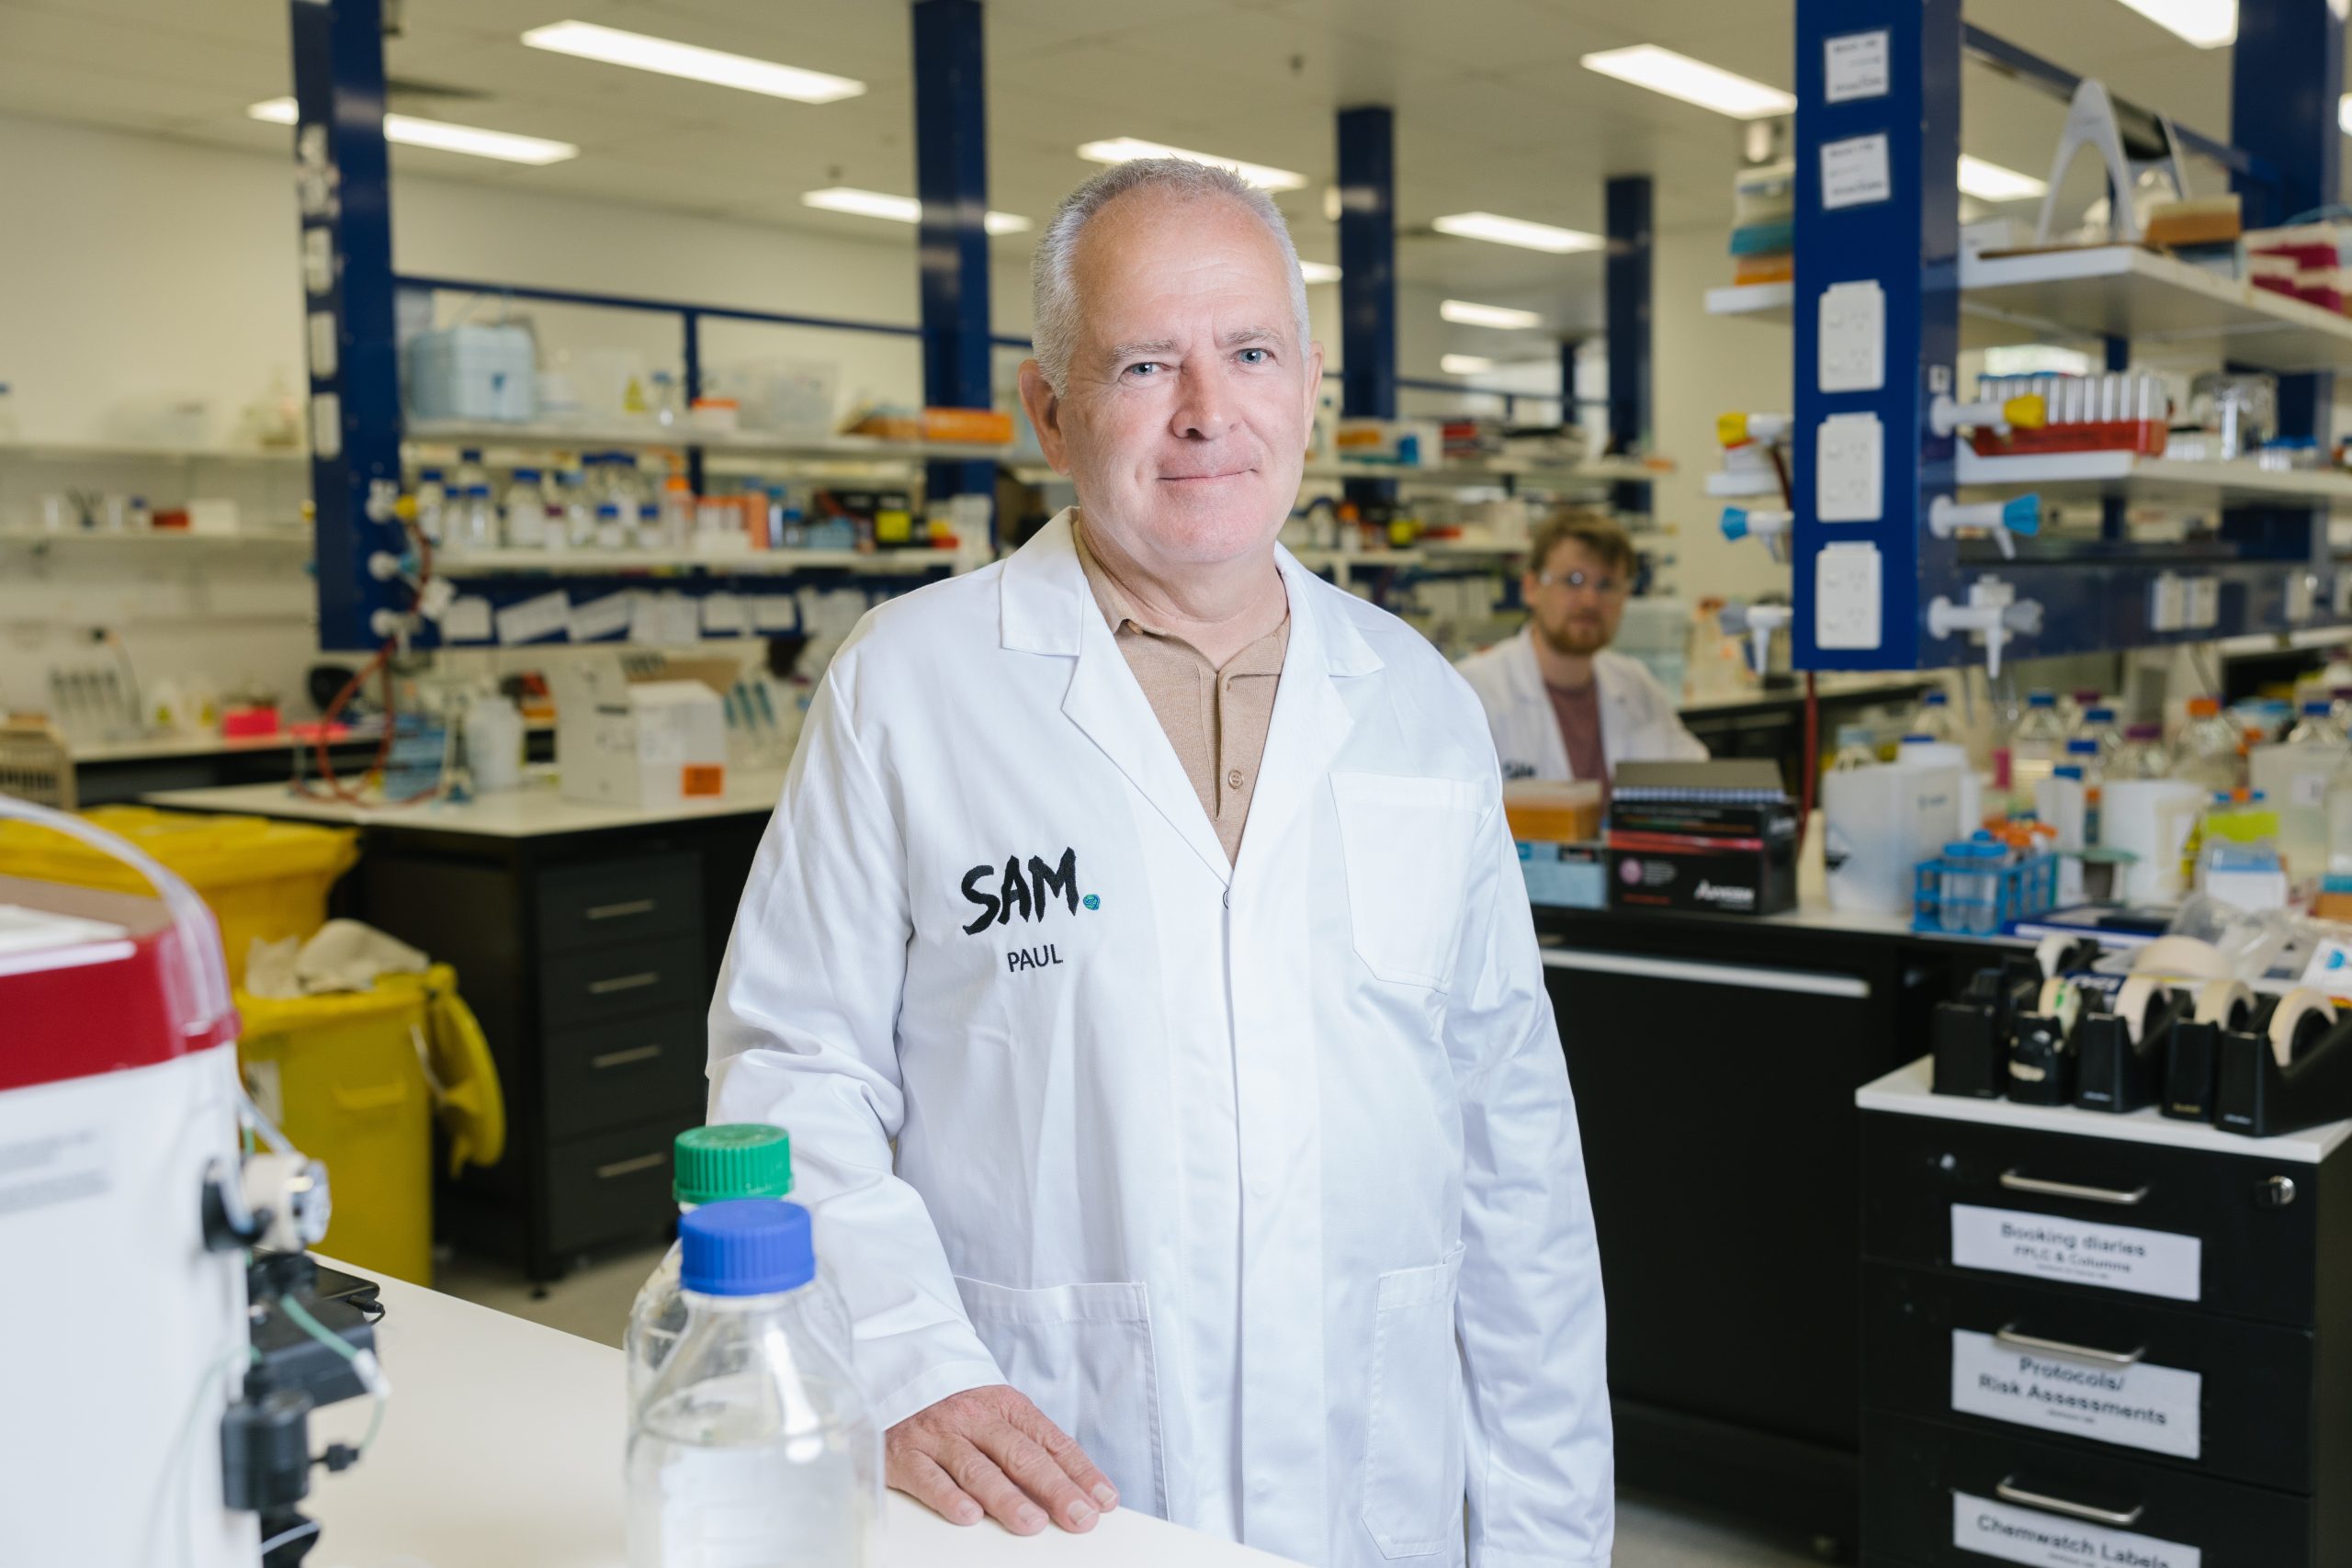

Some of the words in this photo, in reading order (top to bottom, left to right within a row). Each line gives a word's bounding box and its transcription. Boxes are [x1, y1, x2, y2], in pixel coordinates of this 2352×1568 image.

[1007, 943, 1064, 973] PAUL
[2001, 1222, 2076, 1248] Booking
[2082, 1234, 2147, 1257] diaries
[2069, 1253, 2132, 1273] Columns
[1979, 1373, 2021, 1395] Risk
[2027, 1383, 2167, 1426] Assessments
[1977, 1514, 2095, 1555] Chemwatch
[2100, 1540, 2170, 1568] Labels
